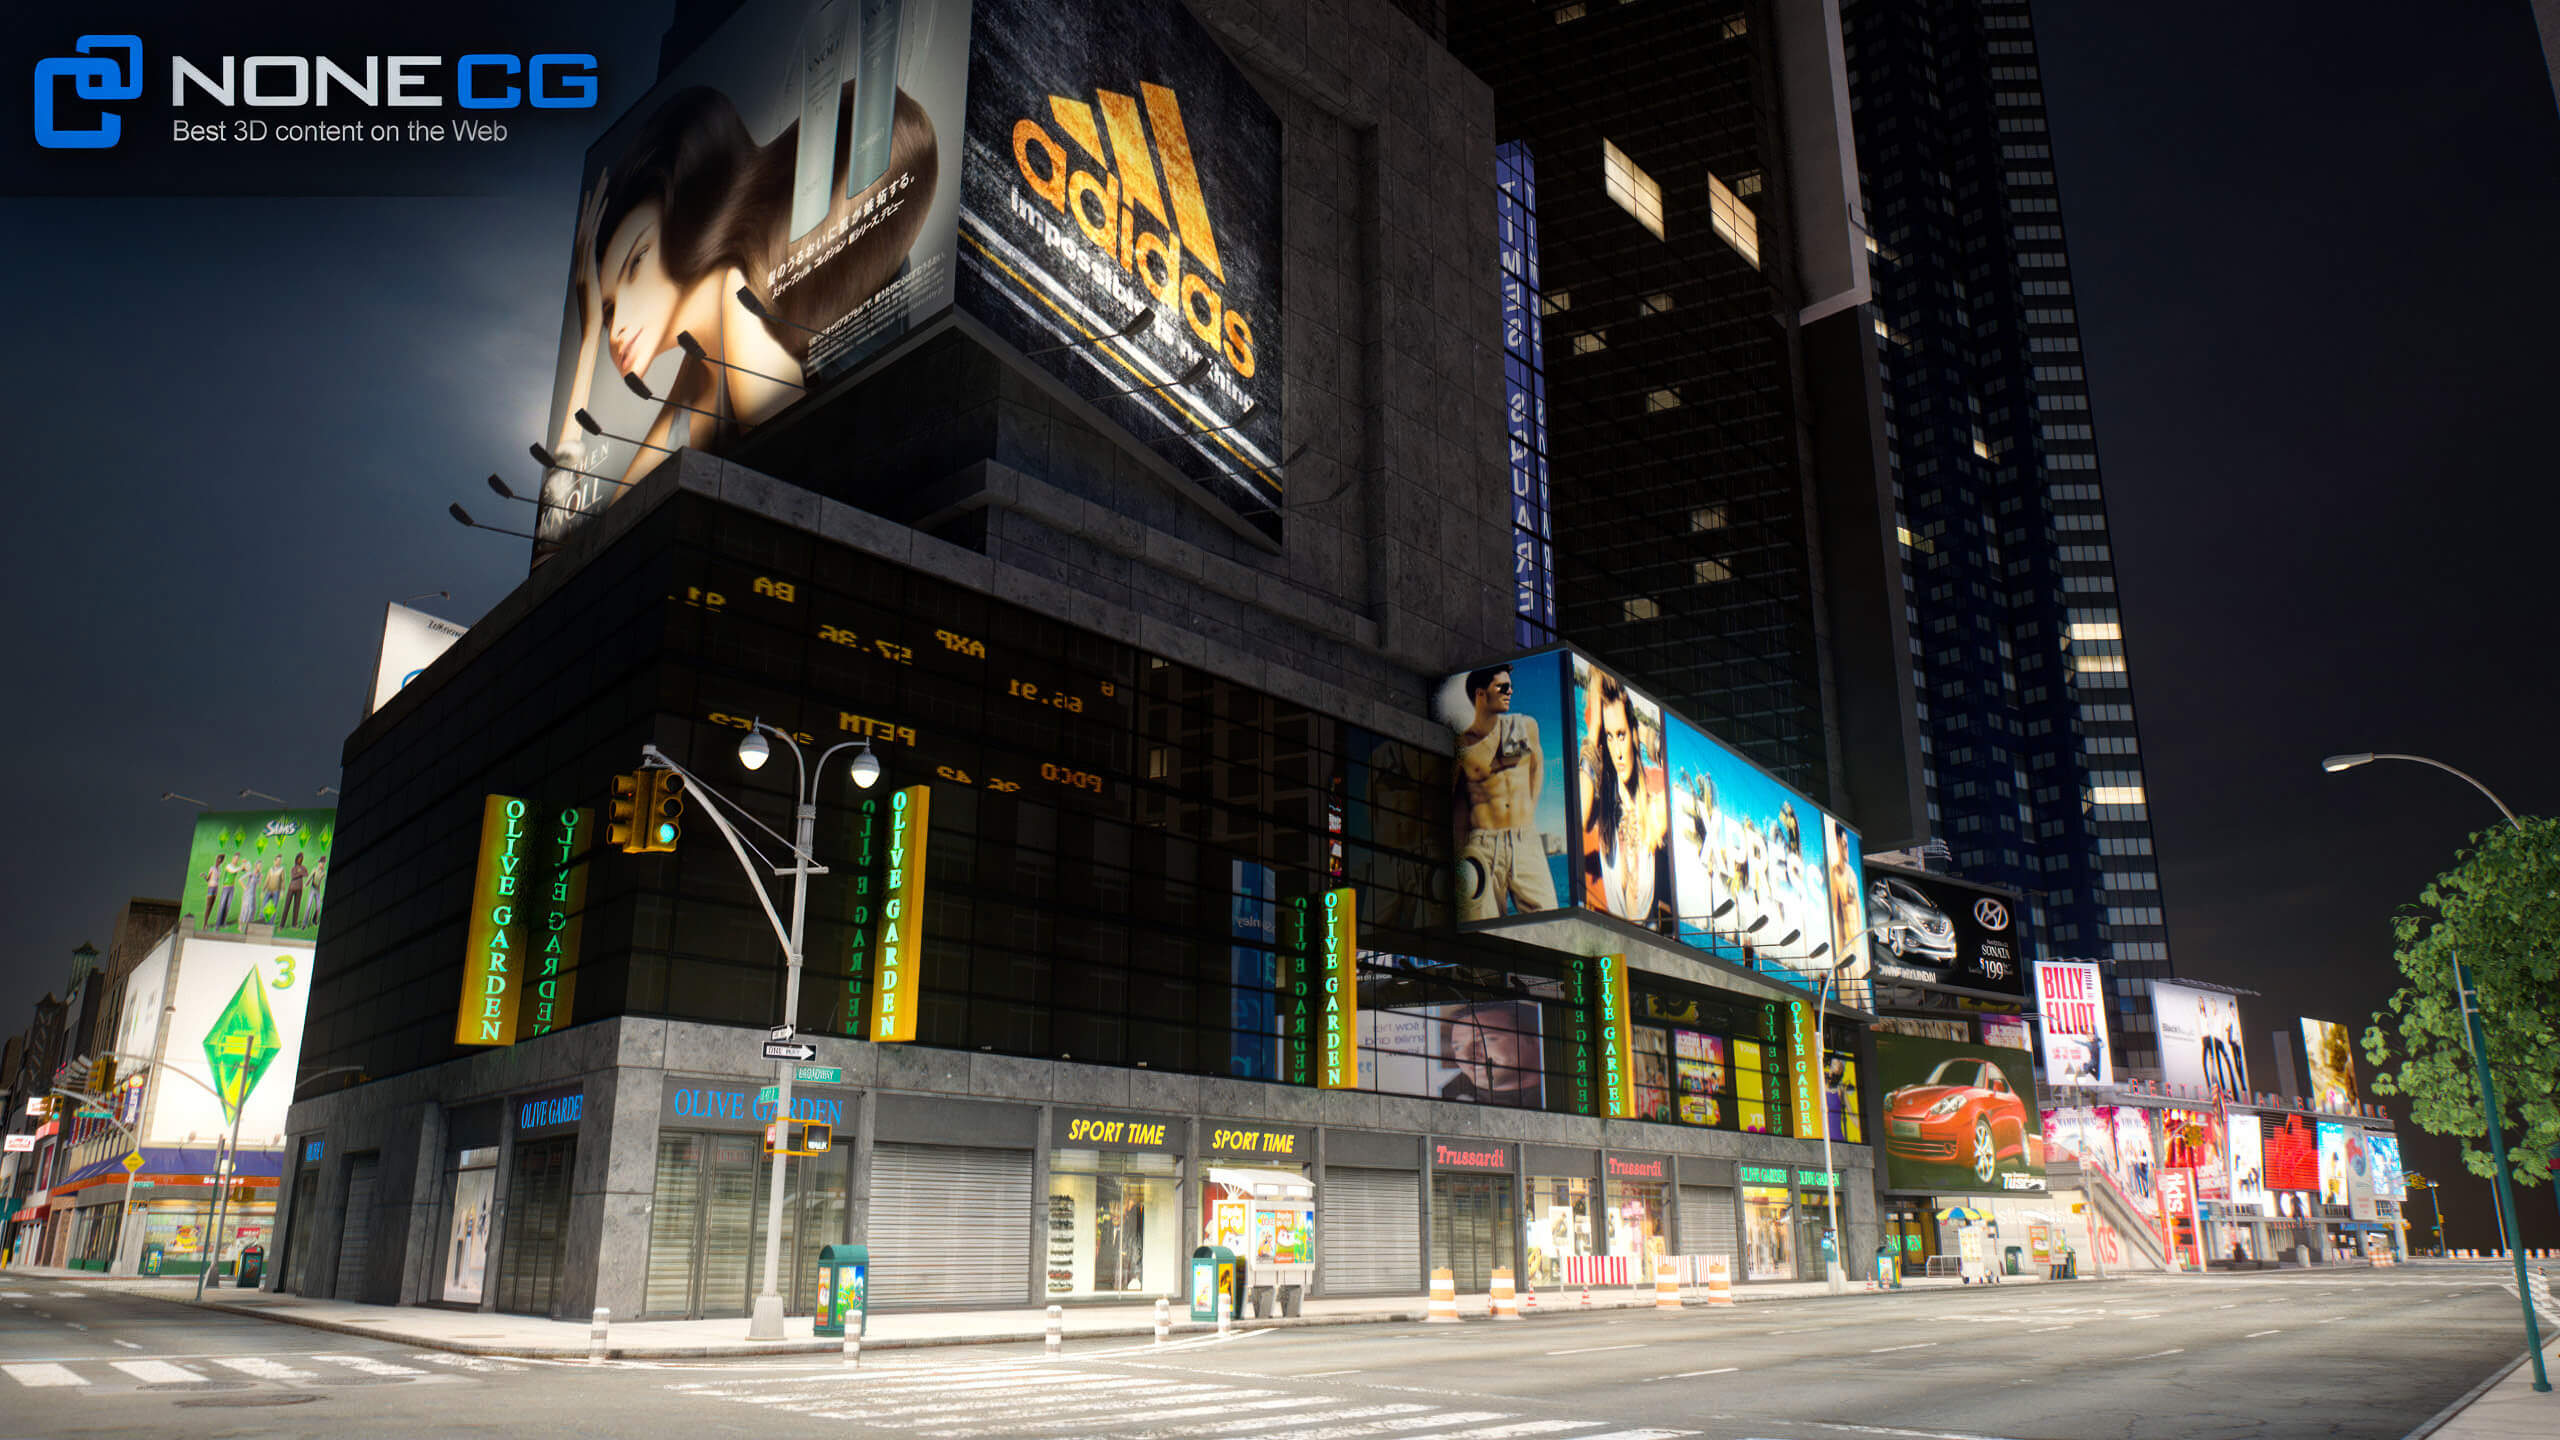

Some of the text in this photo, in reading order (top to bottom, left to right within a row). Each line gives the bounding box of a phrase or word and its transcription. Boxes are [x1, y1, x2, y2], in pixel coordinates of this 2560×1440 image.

[1012, 118, 1256, 379] adidas
[480, 800, 526, 1041] OLIVE GARDEN
[880, 791, 907, 1037] OLIVE GARDEN
[271, 954, 297, 990] 3
[1325, 892, 1342, 1086] OLIVE GARDEN
[2042, 966, 2083, 1000] BILLY
[2046, 1001, 2095, 1035] ELLIOT
[1600, 957, 1622, 1116] OLIVE GARDEN
[1790, 1001, 1813, 1137] OLIVE GARDEN
[521, 1100, 548, 1129] OLIVE
[675, 1088, 744, 1119] OLIVE
[1068, 1119, 1166, 1145] SPORT TIME
[1212, 1129, 1294, 1154] SPORT TIME
[1436, 1145, 1505, 1168] Trussardi
[1608, 1157, 1663, 1178] Trussardi
